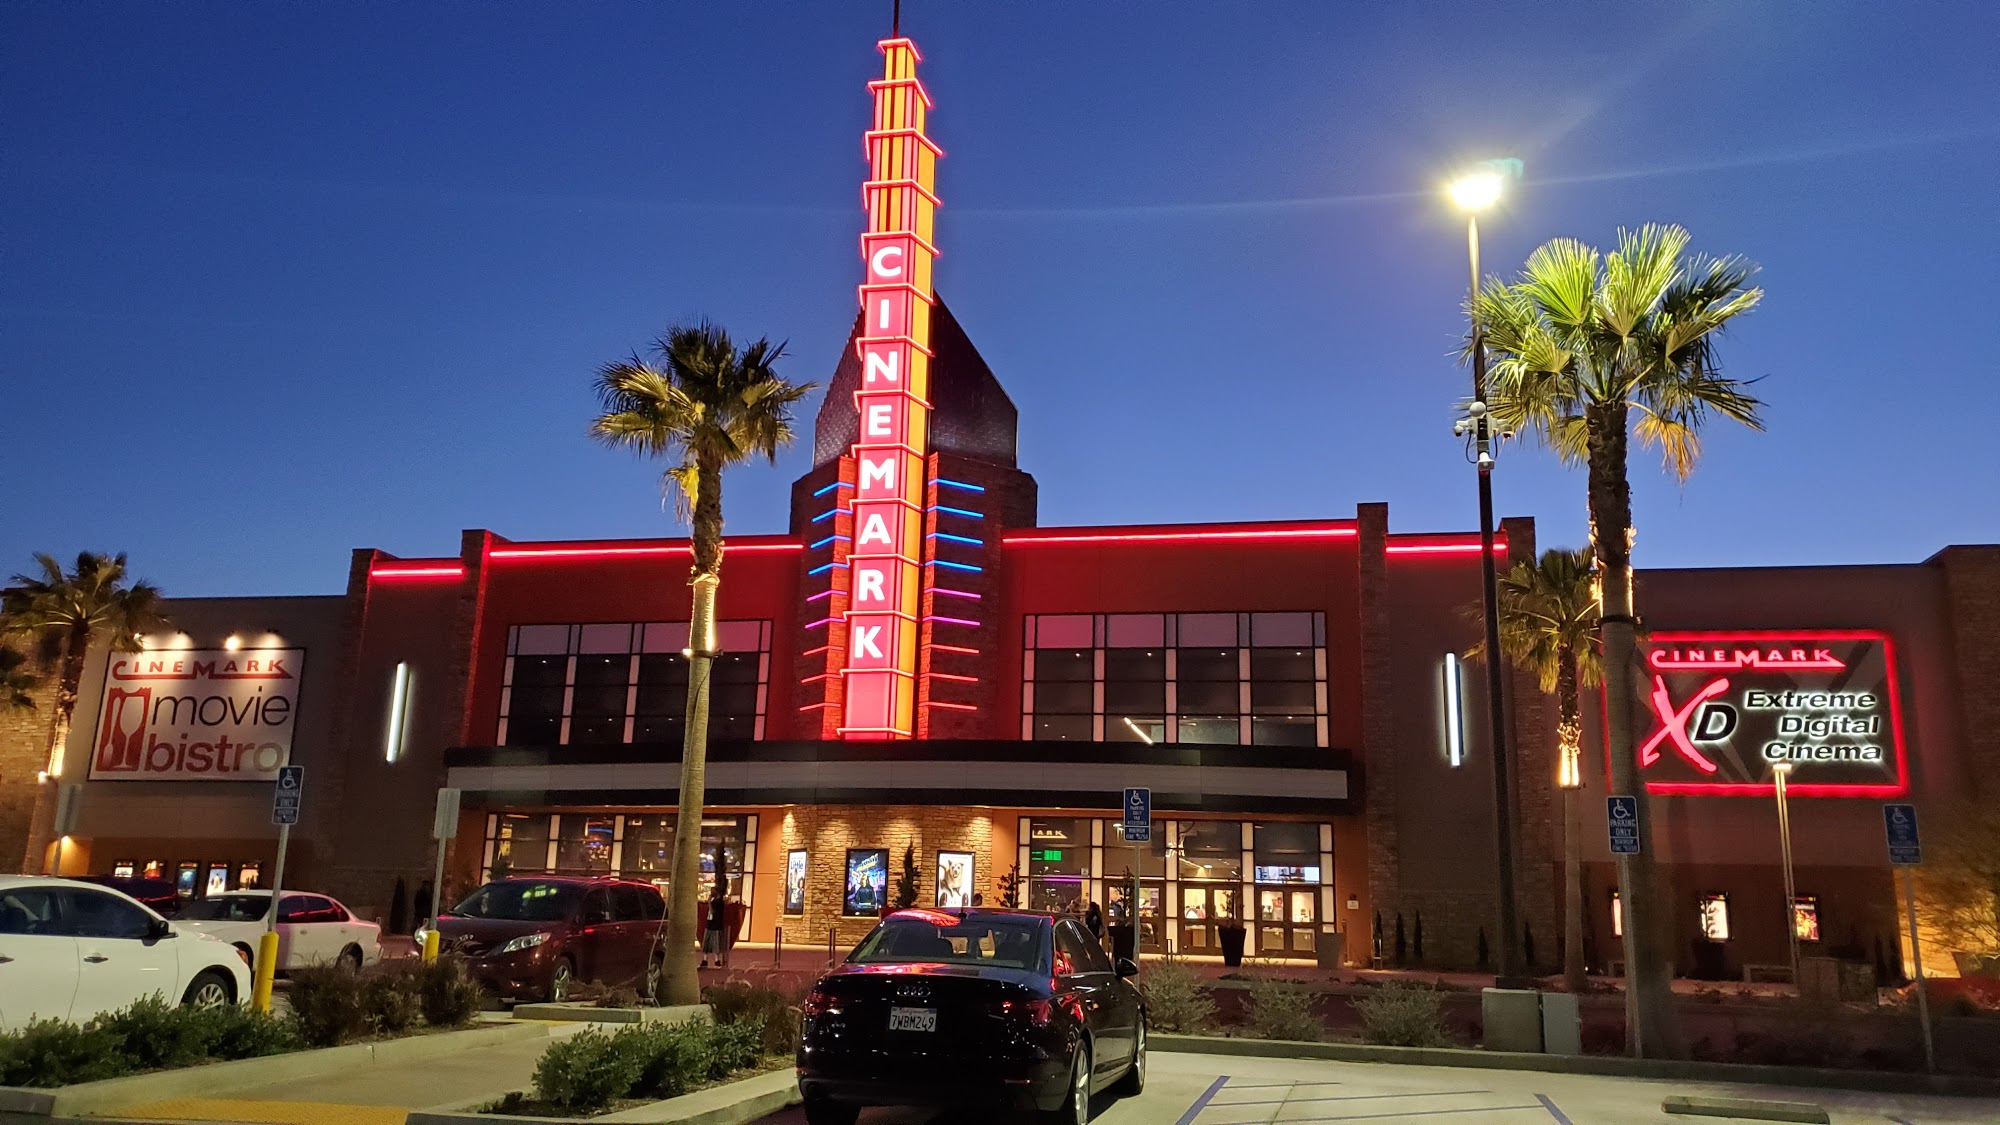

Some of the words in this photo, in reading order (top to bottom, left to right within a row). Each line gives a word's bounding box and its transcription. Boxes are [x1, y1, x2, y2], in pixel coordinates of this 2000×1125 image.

[854, 246, 902, 659] CINEMARK
[1651, 649, 1846, 668] CINEMARK
[111, 659, 293, 680] CINEMARK
[151, 686, 290, 726] movie
[1746, 691, 1876, 708] Extreme
[1780, 716, 1879, 737] Digital
[144, 733, 283, 772] bistro
[1764, 742, 1882, 760] Cinema
